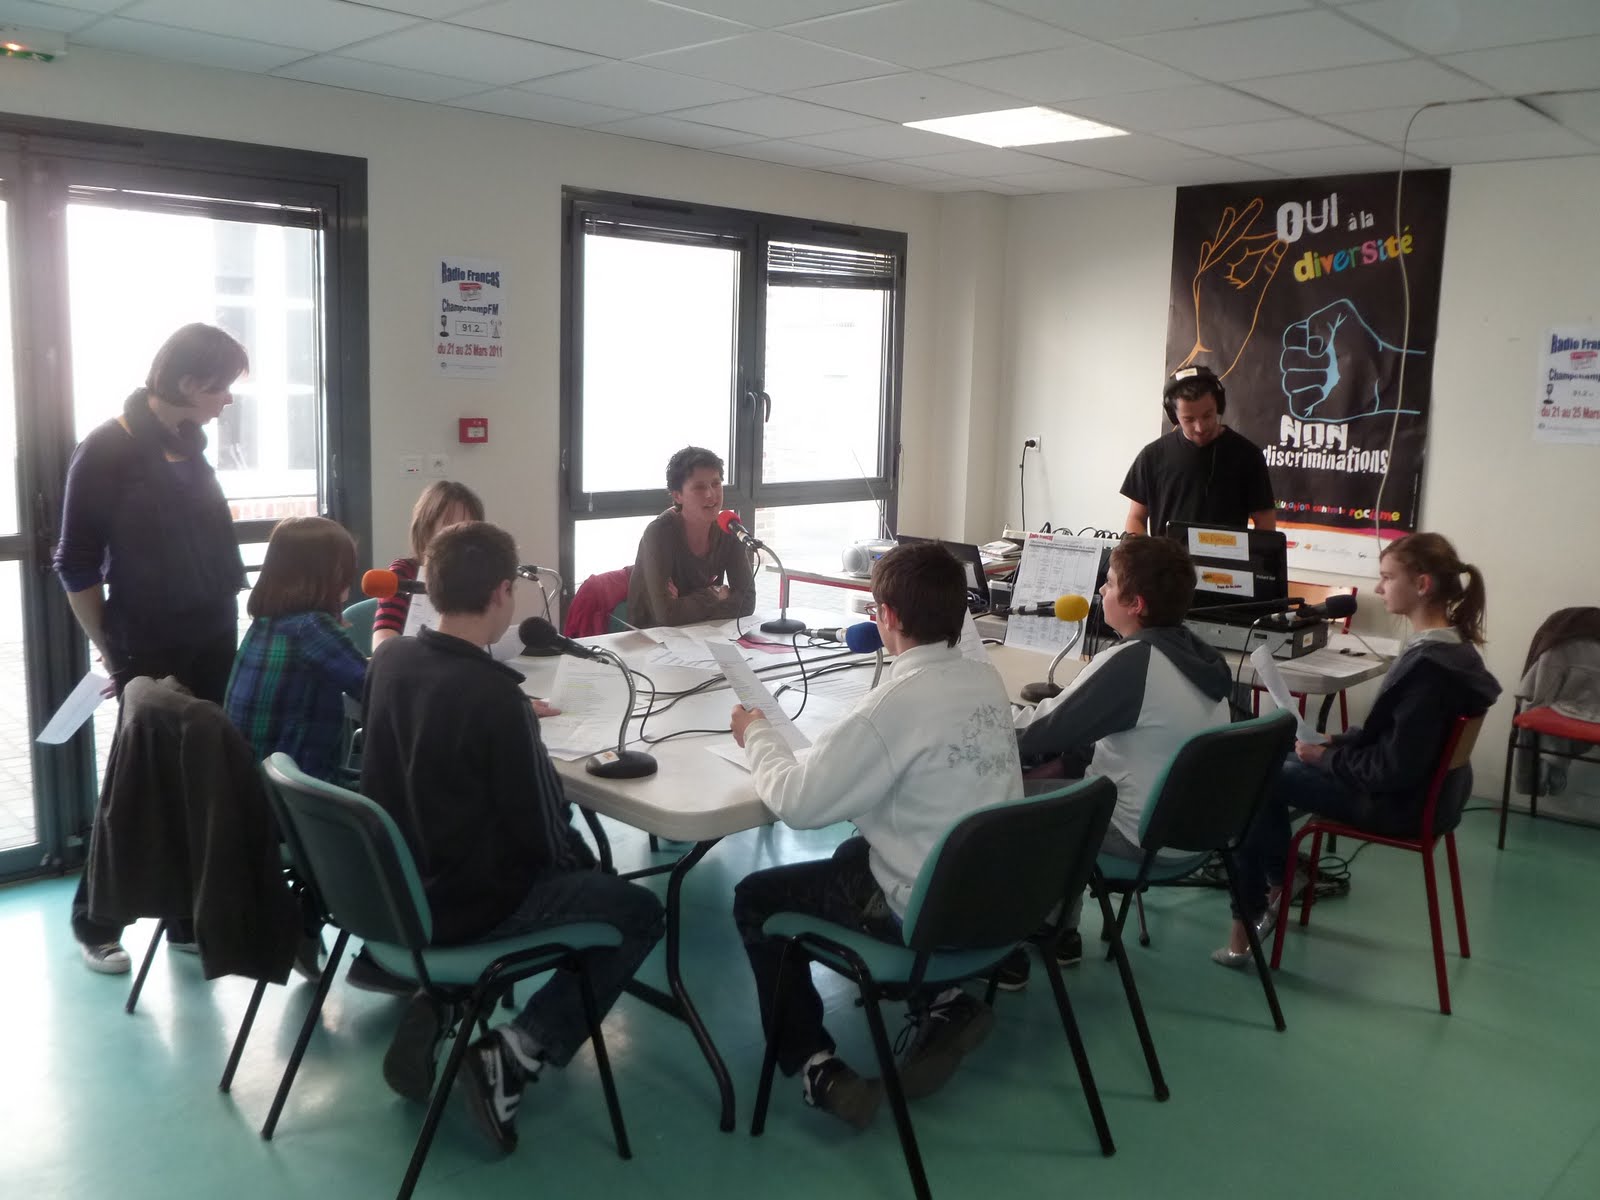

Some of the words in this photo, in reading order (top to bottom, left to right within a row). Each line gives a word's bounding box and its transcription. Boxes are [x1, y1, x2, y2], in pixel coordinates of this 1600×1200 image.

[1277, 193, 1338, 243] OUI
[1348, 212, 1357, 231] à
[1360, 210, 1374, 229] la
[1294, 225, 1413, 282] diversité
[441, 261, 466, 284] Radio
[462, 323, 480, 333] 91.2
[437, 342, 446, 355] du
[447, 343, 455, 355] 21
[456, 345, 464, 356] au
[465, 344, 473, 356] 25
[473, 345, 488, 357] Mars
[489, 346, 503, 358] 2011
[1550, 333, 1580, 354] Radio
[1541, 405, 1551, 417] du
[1552, 406, 1560, 417] 21
[1562, 408, 1571, 418] au
[1573, 406, 1581, 418] 25
[1280, 414, 1348, 451] NON
[1262, 444, 1389, 474] discriminations
